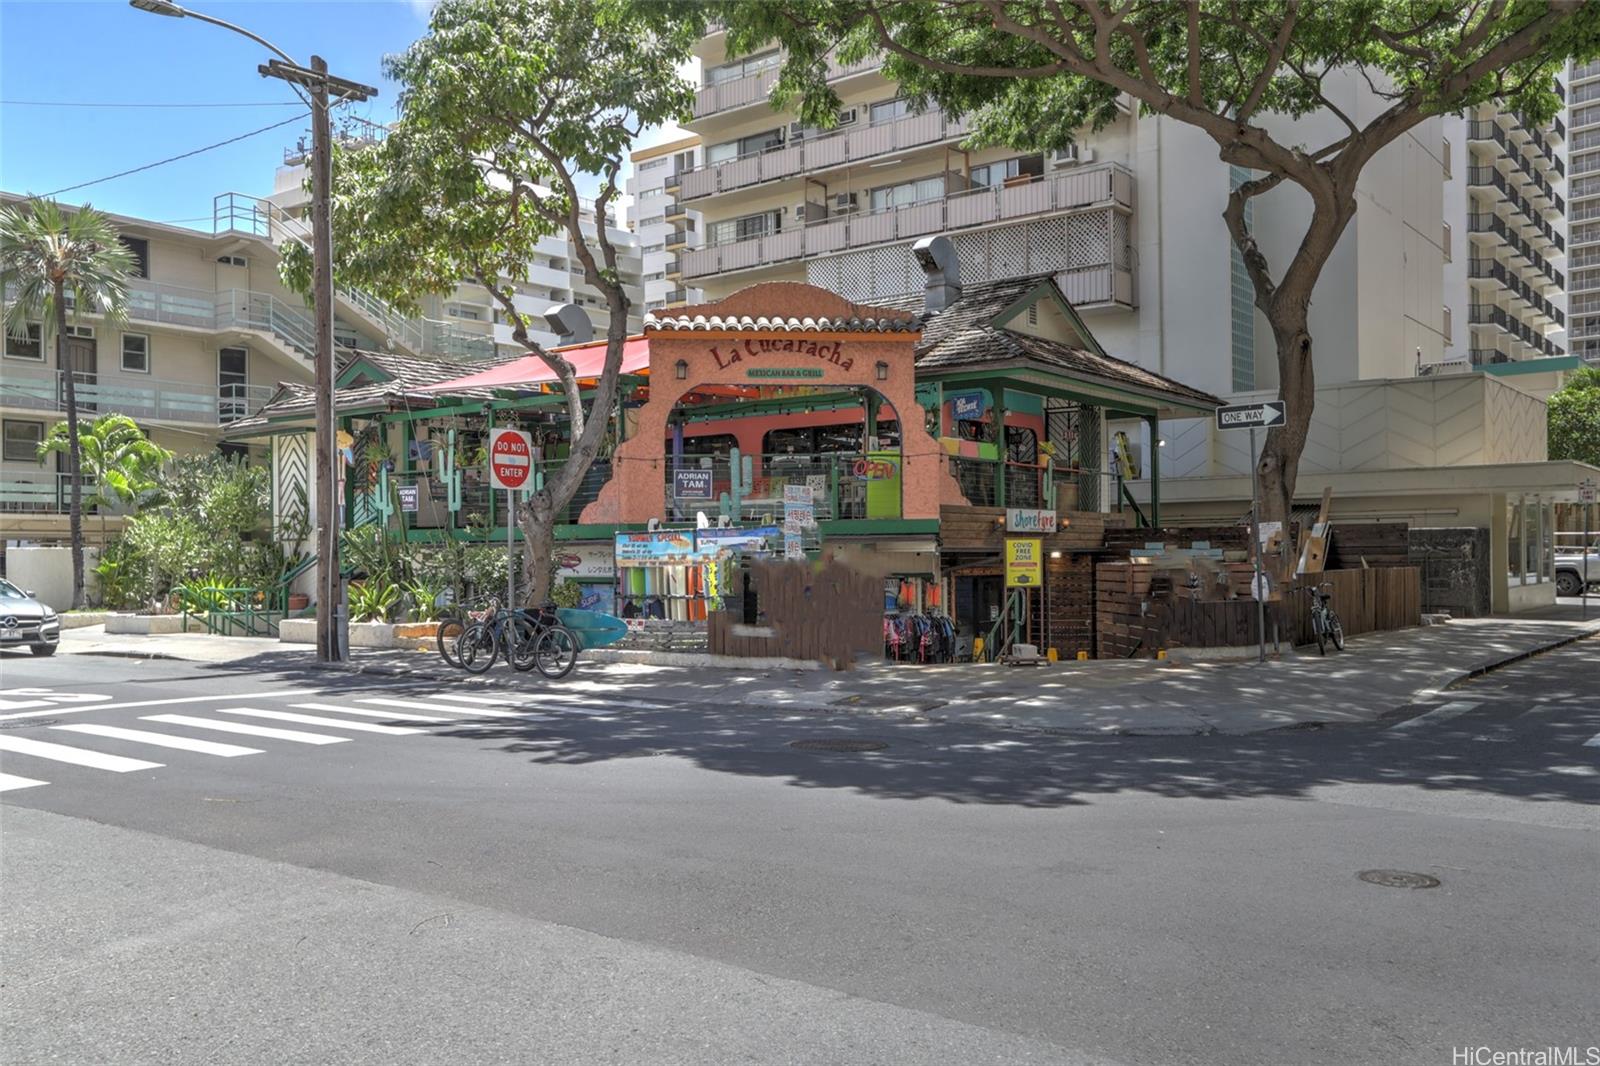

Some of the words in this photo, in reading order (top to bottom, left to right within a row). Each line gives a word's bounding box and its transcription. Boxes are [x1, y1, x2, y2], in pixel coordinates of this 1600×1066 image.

[709, 346, 743, 370] La
[744, 339, 853, 371] Cucaracha
[748, 369, 781, 377] MEXICAN
[782, 369, 795, 377] BAR
[802, 369, 822, 377] GRILL
[1224, 411, 1241, 423] ONE
[1244, 410, 1264, 421] WAY
[497, 441, 508, 451] DO
[511, 442, 526, 452] NOT
[500, 467, 523, 477] ENTER
[853, 460, 893, 480] OPEN
[682, 480, 704, 488] TAM
[1015, 510, 1054, 531] shorefyre
